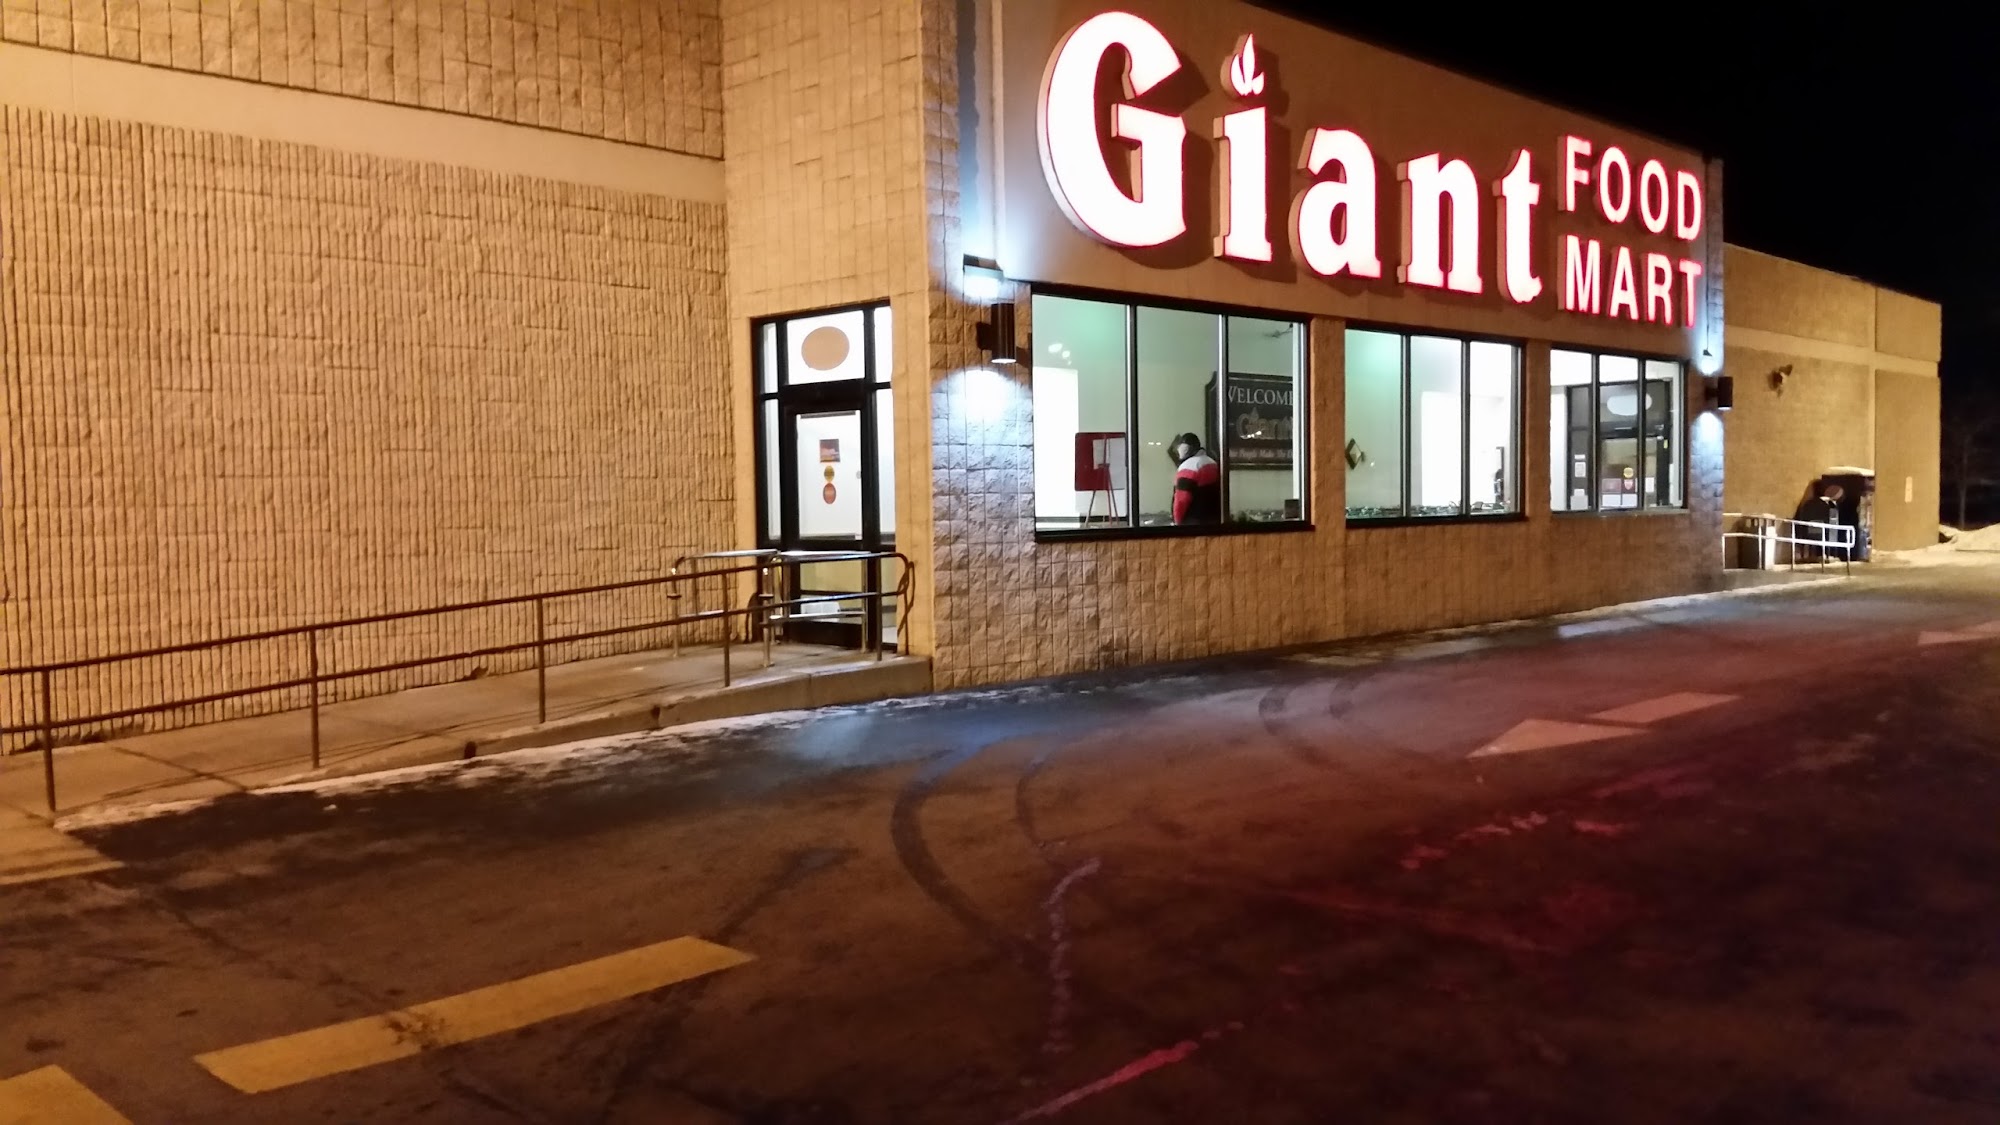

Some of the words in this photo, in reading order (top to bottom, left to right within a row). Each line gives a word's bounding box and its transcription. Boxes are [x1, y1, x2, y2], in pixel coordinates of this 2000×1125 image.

[1041, 11, 1543, 303] Giant
[1564, 134, 1702, 241] FOOD
[1564, 234, 1702, 329] MART
